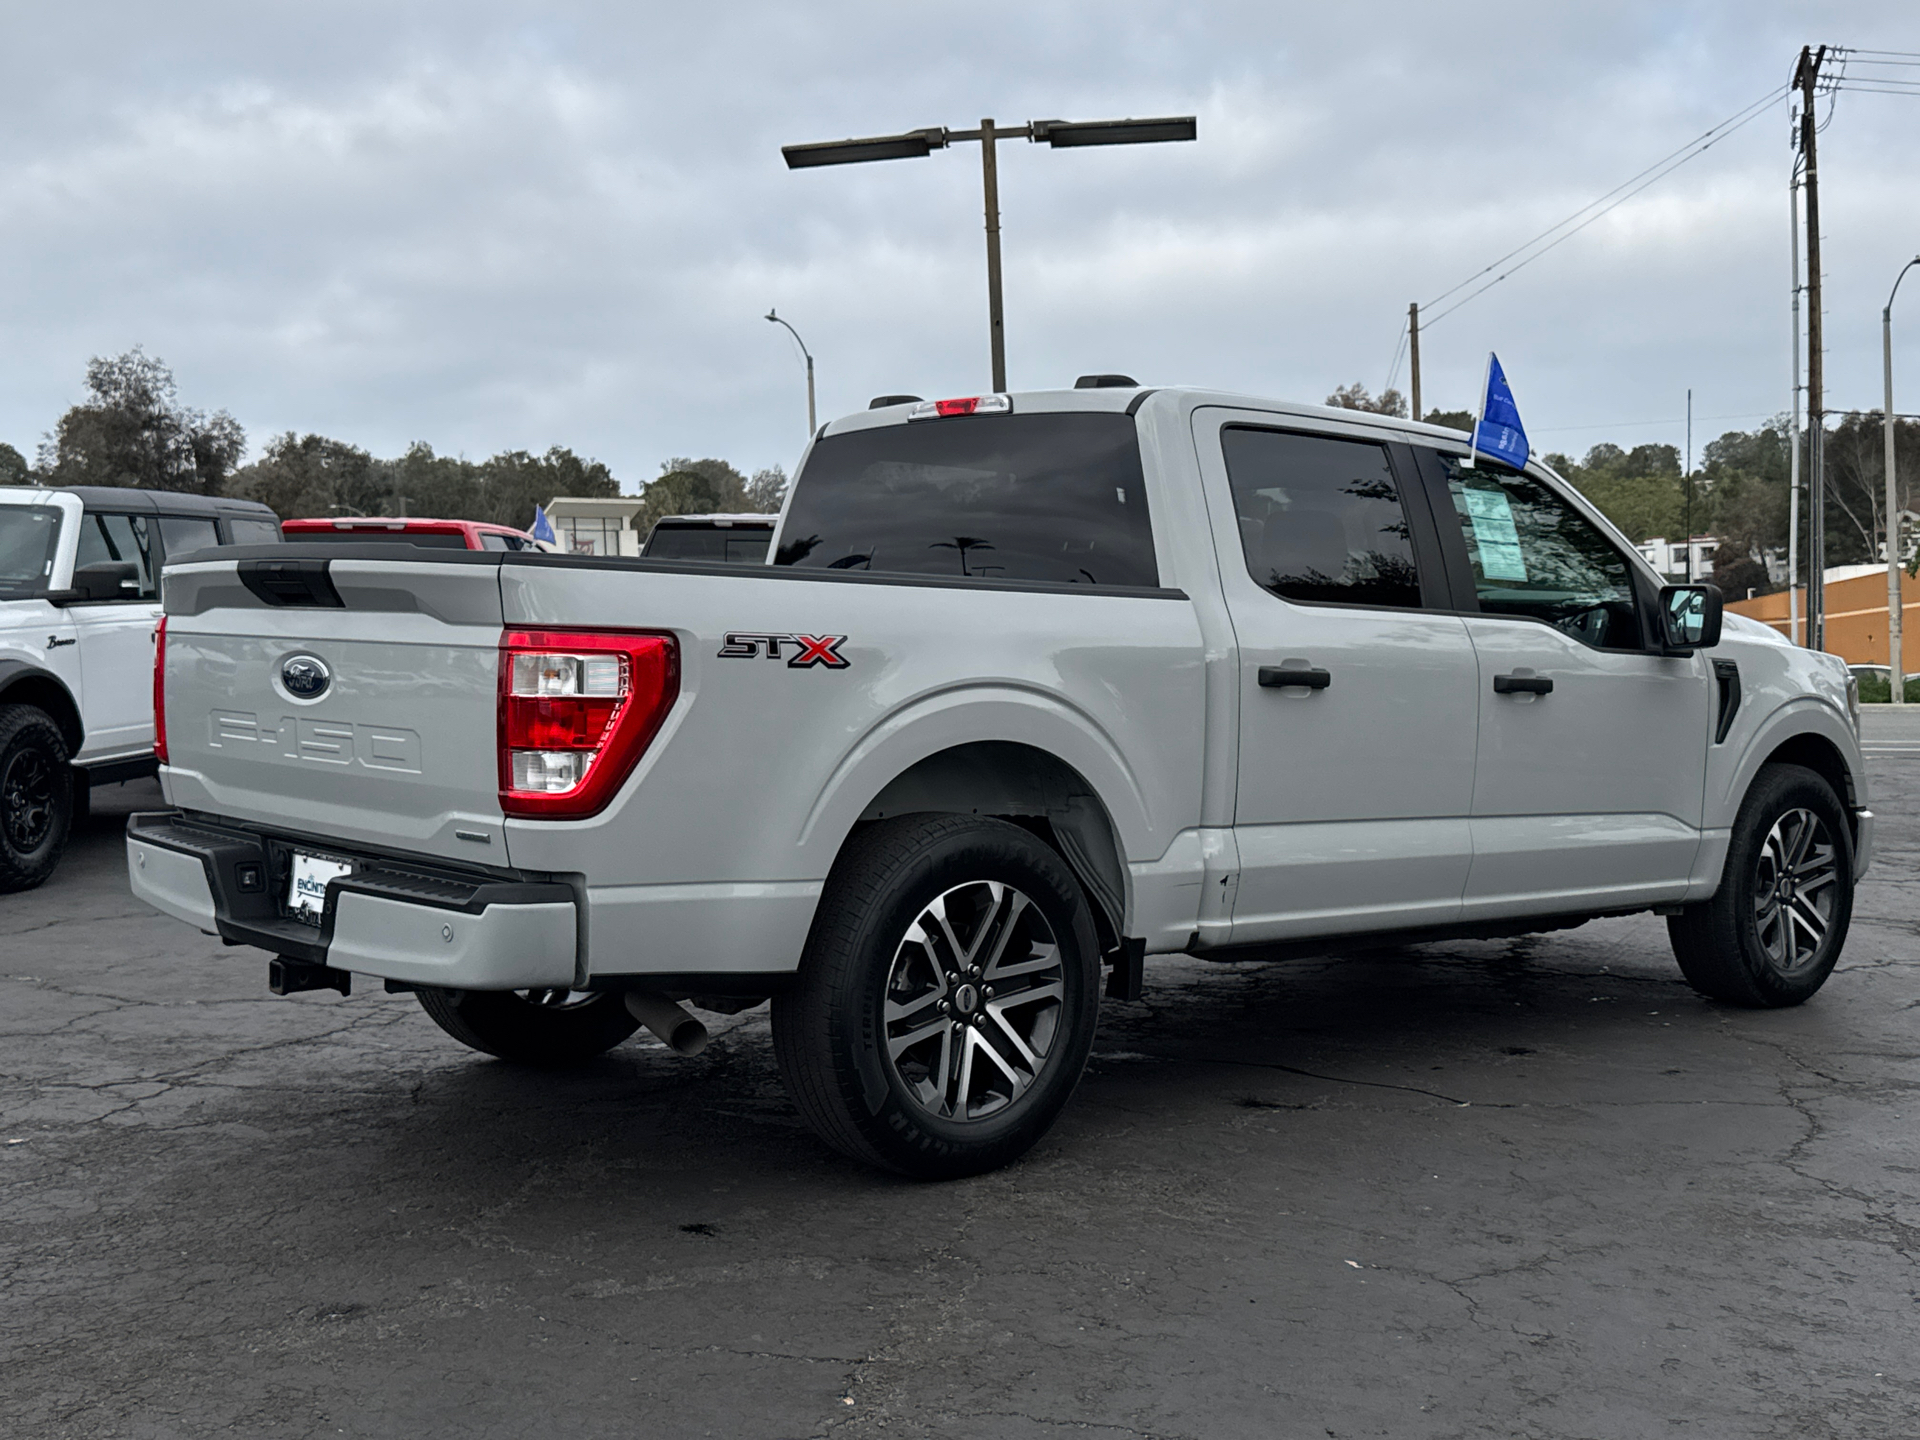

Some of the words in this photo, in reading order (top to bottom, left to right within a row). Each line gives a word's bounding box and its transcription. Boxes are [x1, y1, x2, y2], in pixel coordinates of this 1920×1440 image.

[717, 631, 851, 669] STX
[290, 664, 315, 689] Ford
[209, 708, 422, 774] F-150
